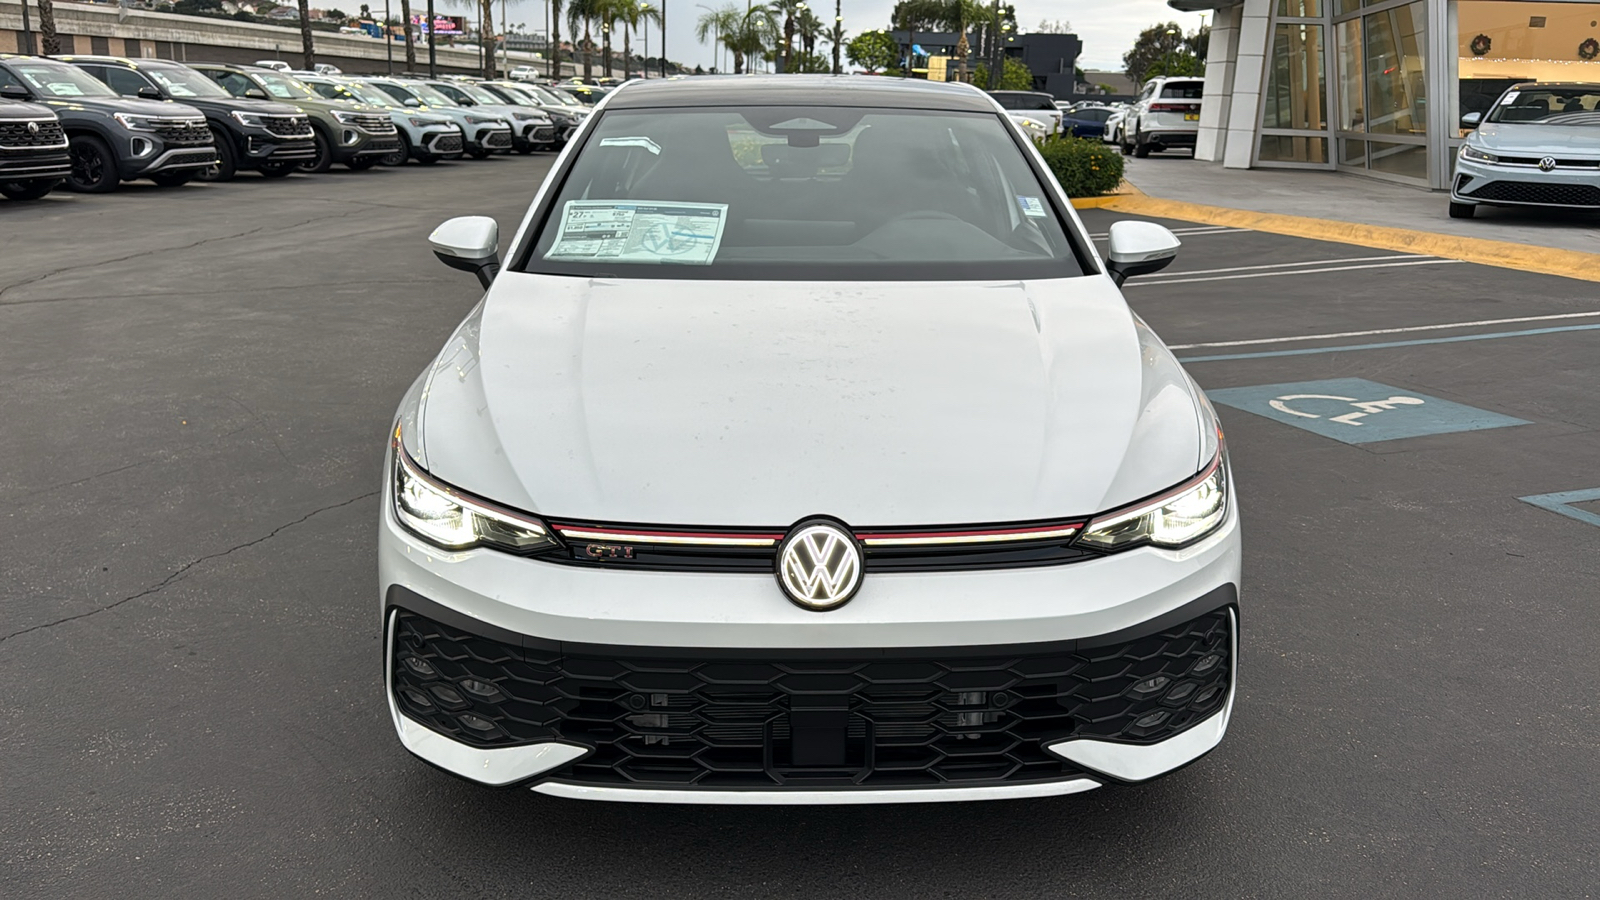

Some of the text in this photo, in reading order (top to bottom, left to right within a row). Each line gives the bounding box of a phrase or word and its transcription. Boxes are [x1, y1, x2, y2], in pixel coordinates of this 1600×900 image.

[573, 211, 584, 219] 27
[585, 543, 634, 559] GTI
[782, 527, 859, 604] VW
